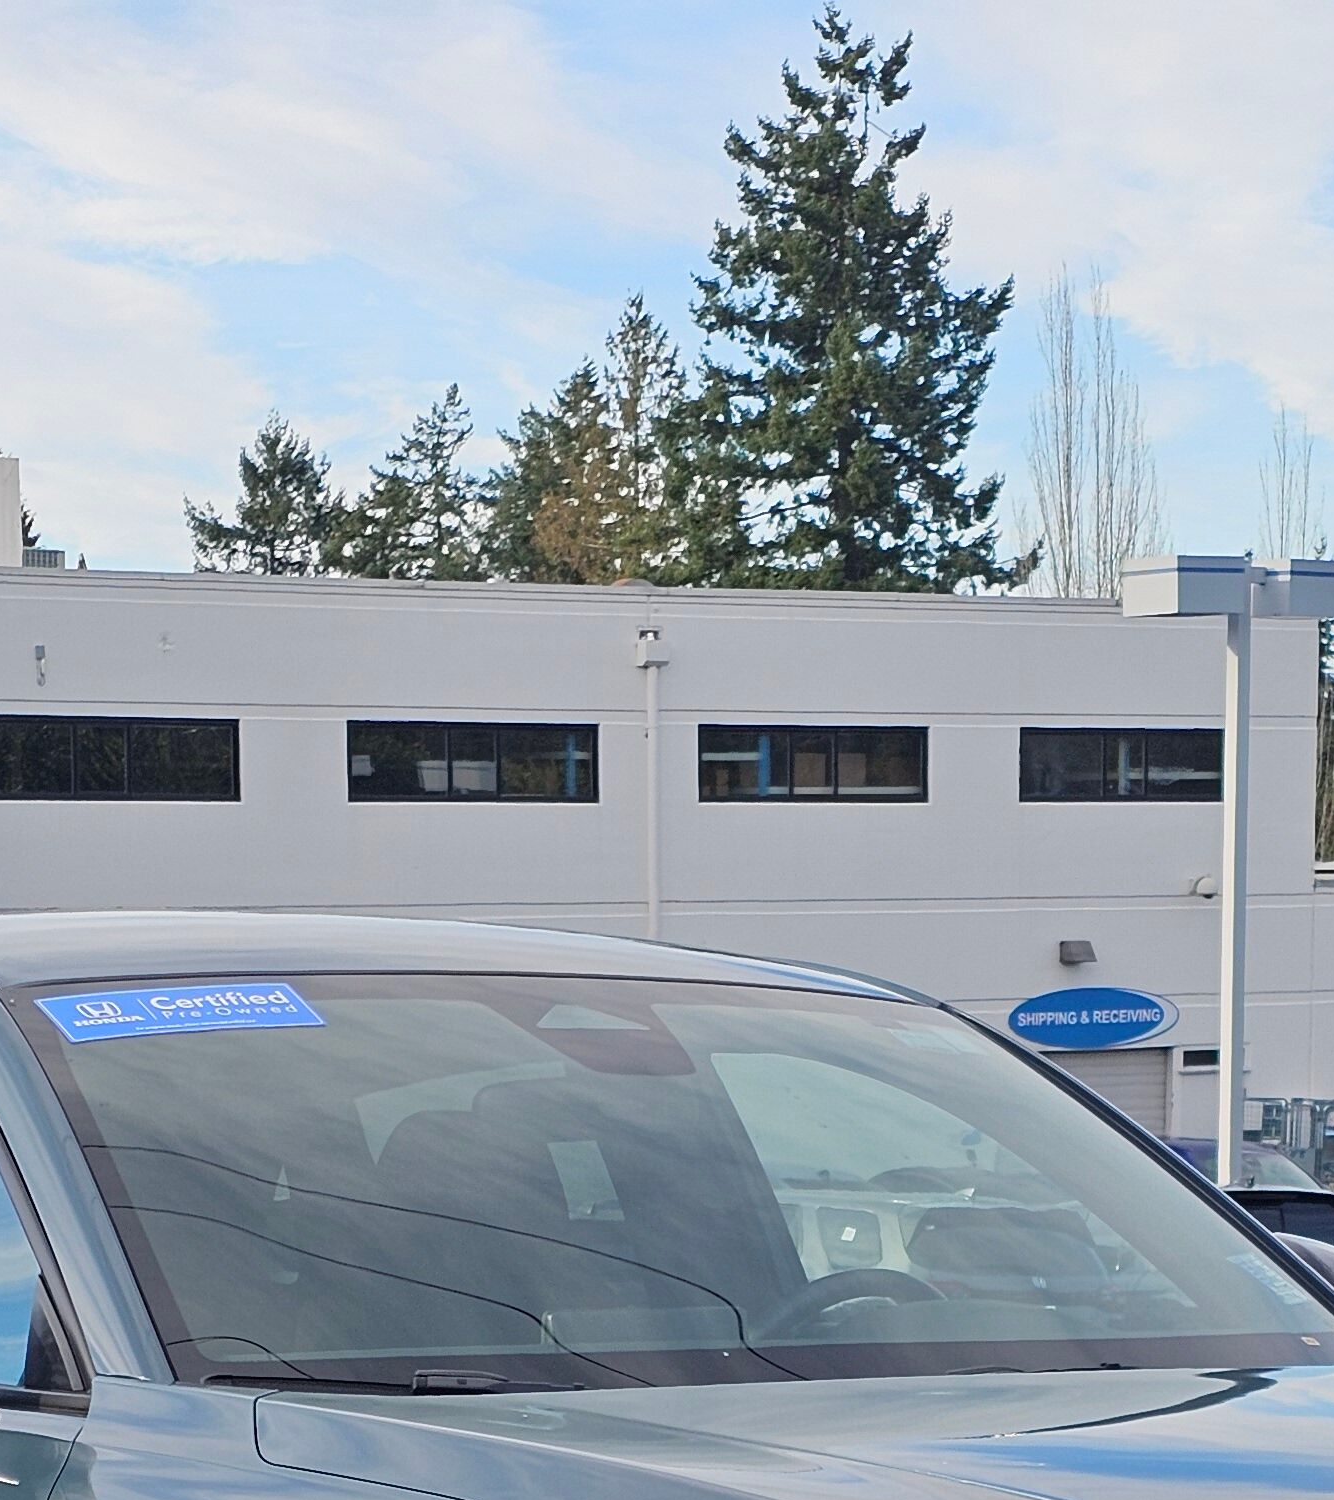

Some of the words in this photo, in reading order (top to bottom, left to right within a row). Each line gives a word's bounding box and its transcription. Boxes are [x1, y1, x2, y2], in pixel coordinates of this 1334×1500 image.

[149, 991, 289, 1011] Certified
[161, 1004, 298, 1020] Pre-Owned
[1018, 1012, 1077, 1027] SHIPPING
[1080, 1011, 1089, 1024] &
[1093, 1009, 1161, 1024] RECEIVING
[73, 1015, 146, 1027] HONDA
